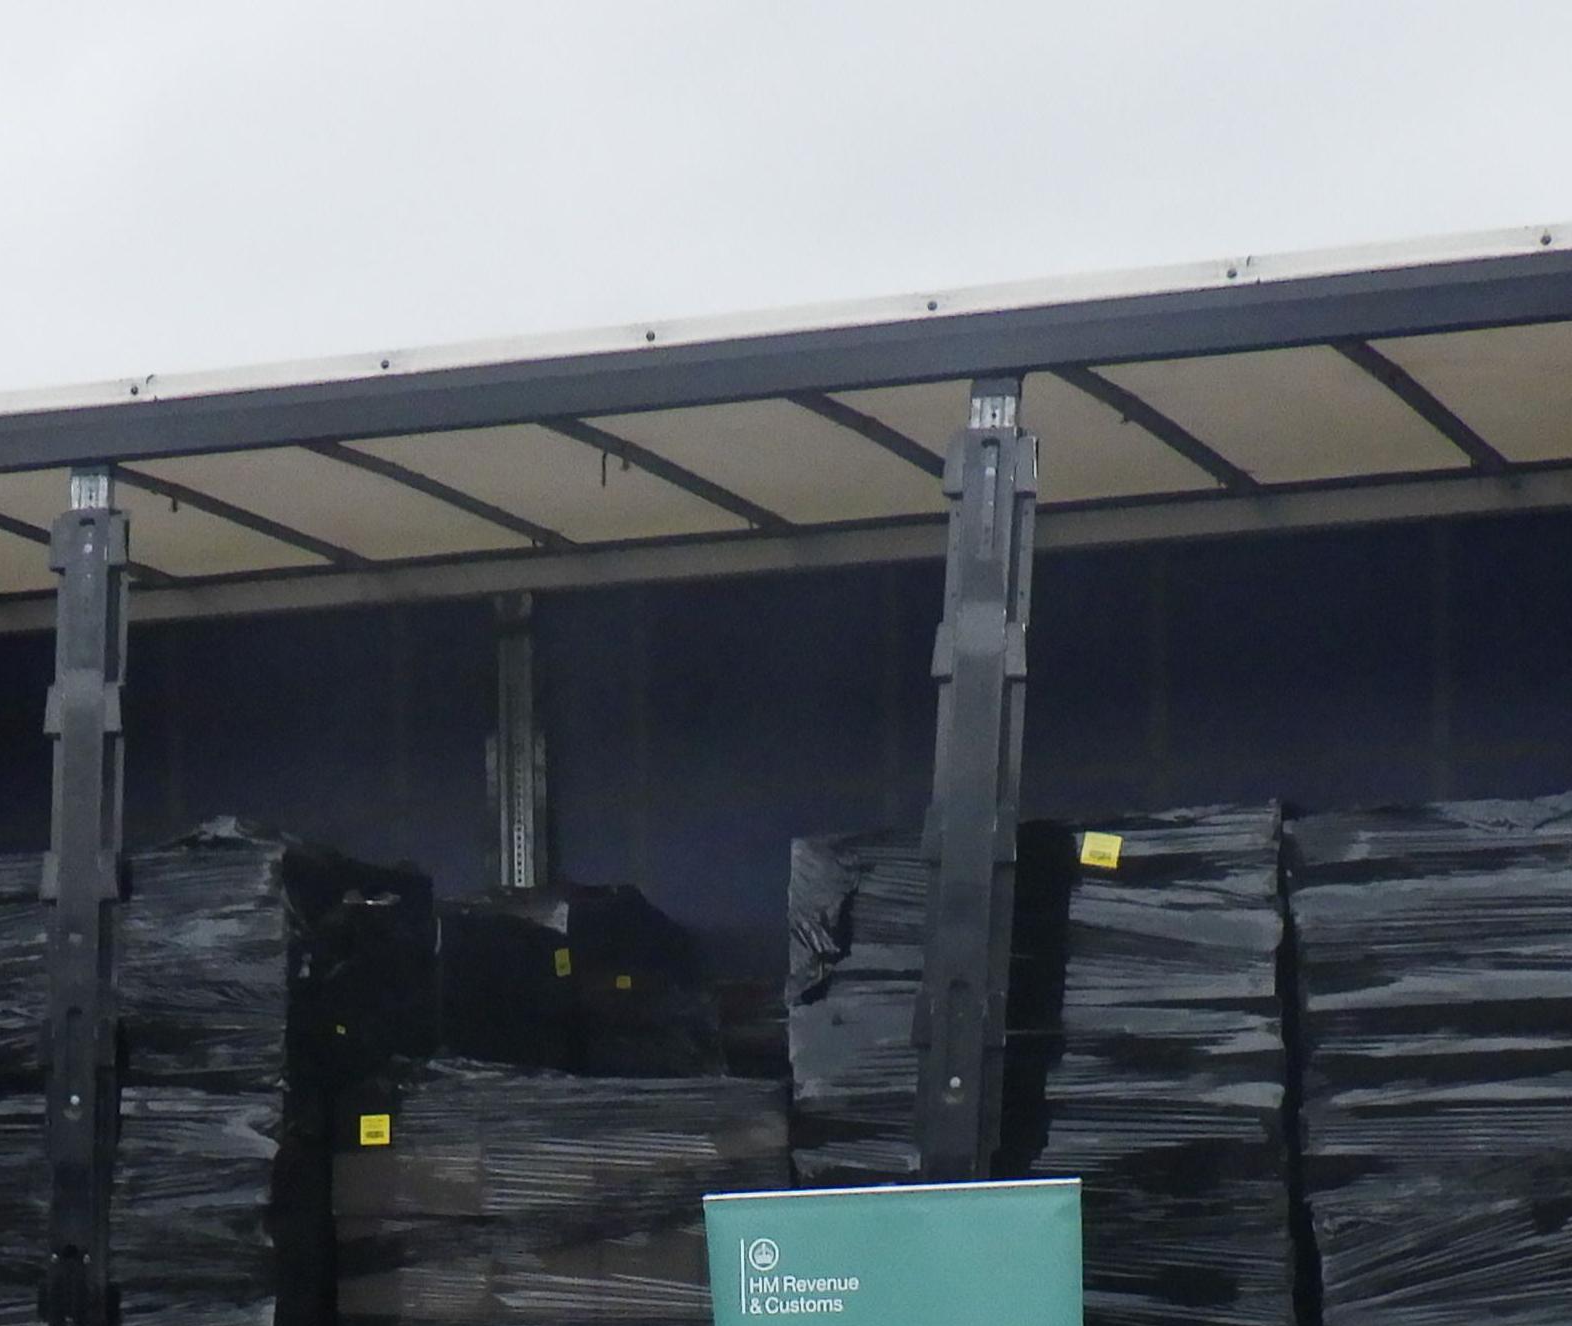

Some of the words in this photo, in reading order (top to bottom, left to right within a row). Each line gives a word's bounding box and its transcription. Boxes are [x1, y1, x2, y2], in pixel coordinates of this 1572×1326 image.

[749, 1277, 779, 1293] HM
[783, 1275, 859, 1292] Revenue
[749, 1298, 762, 1315] &
[765, 1297, 843, 1313] Customs
